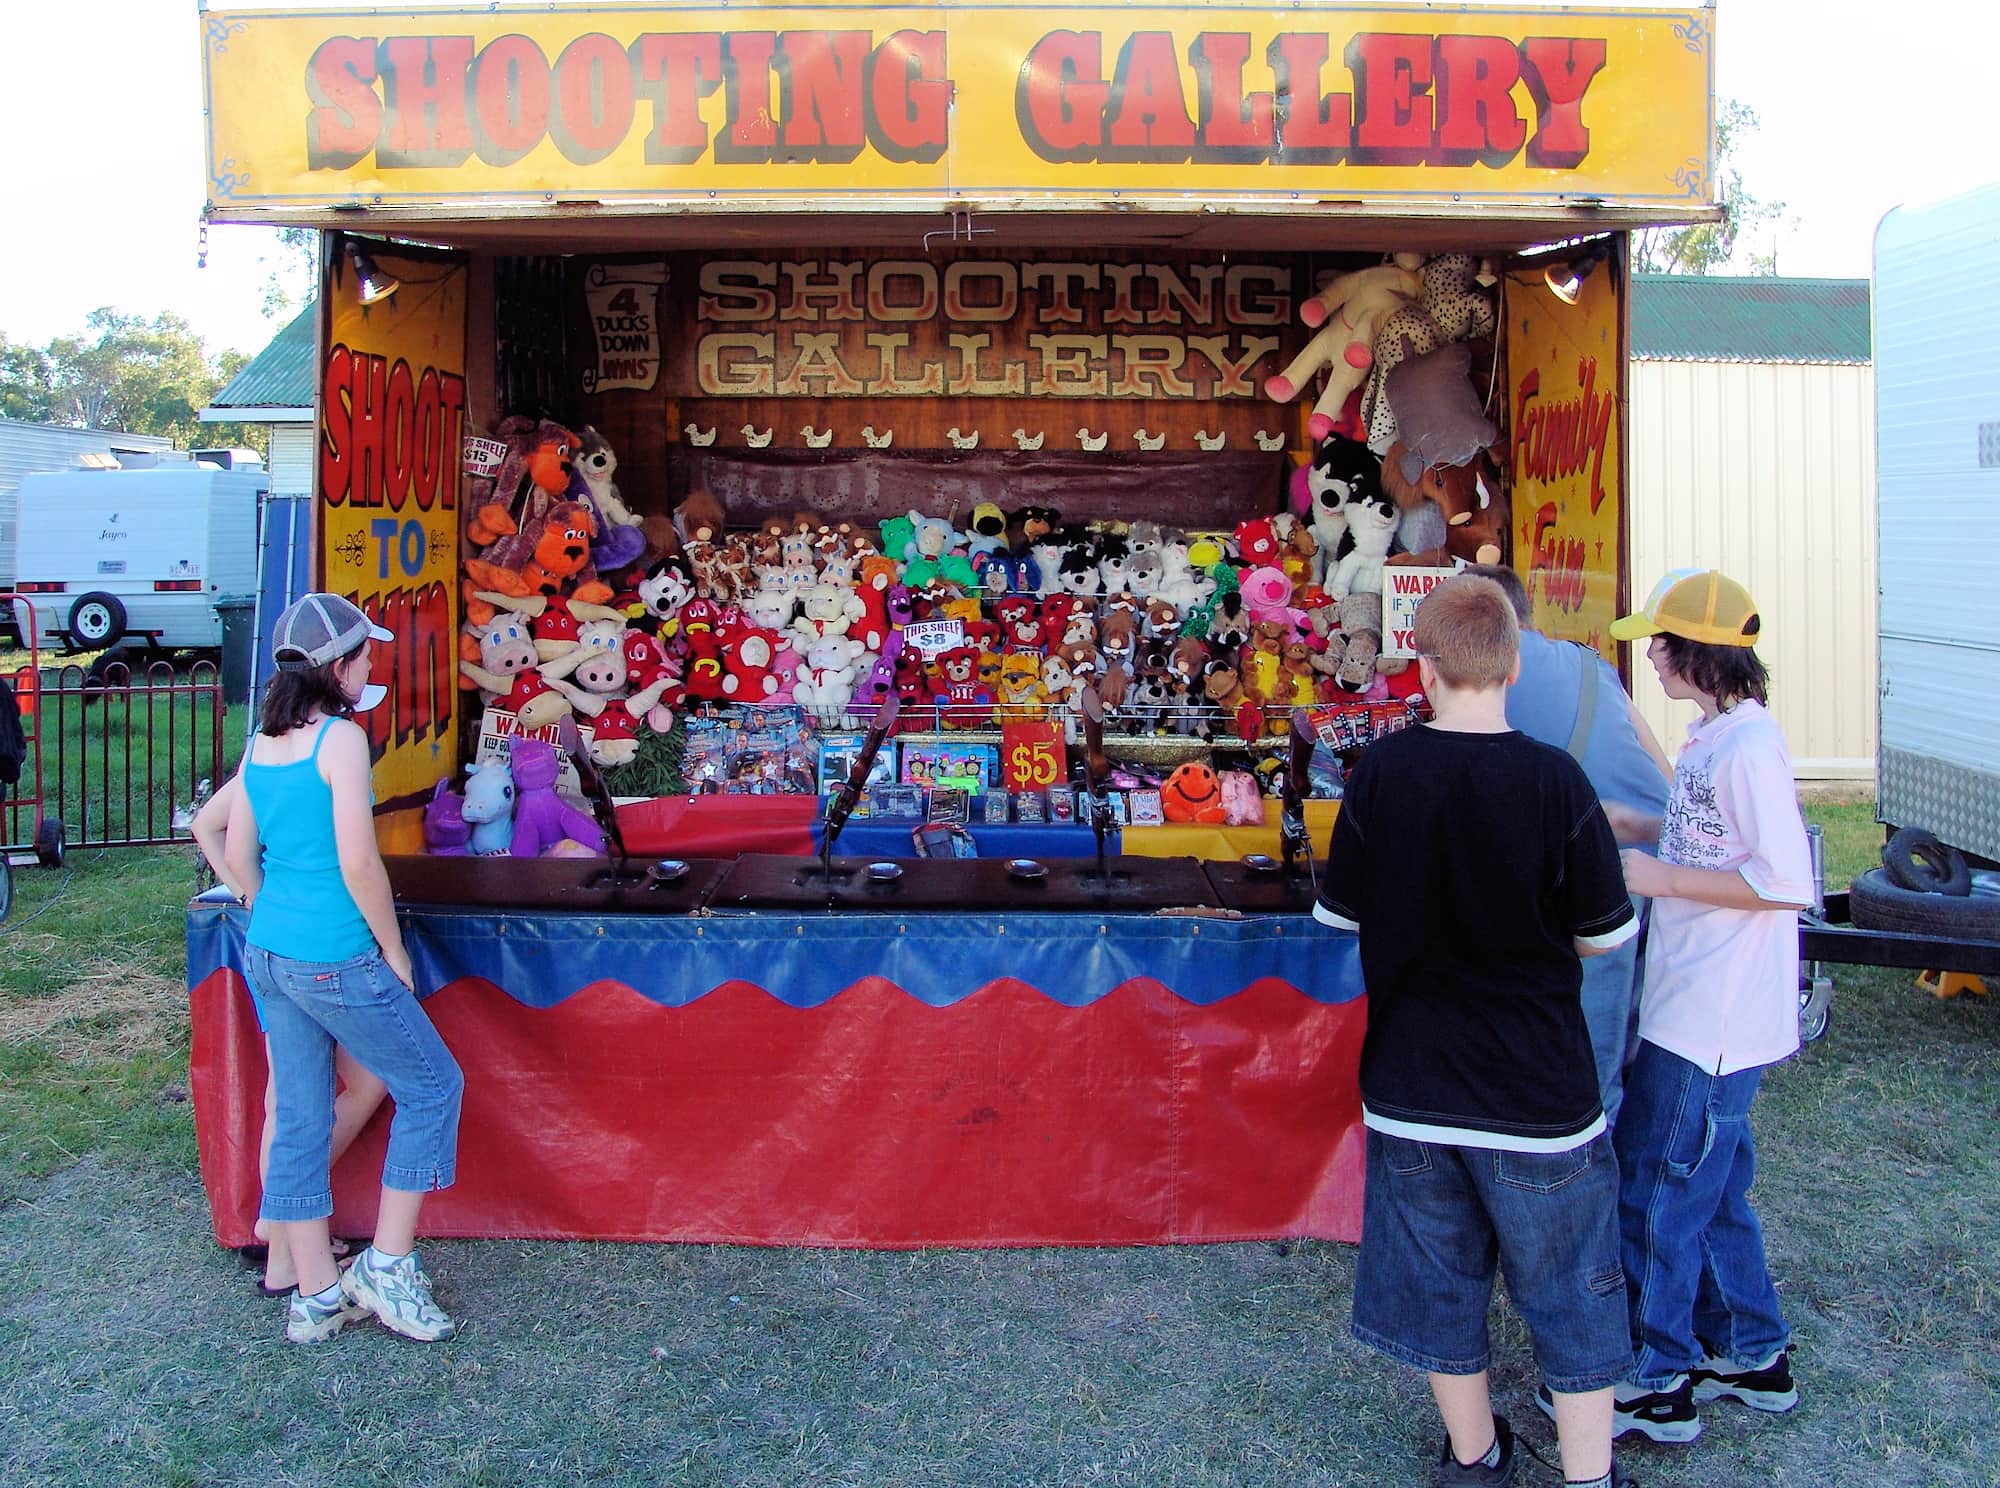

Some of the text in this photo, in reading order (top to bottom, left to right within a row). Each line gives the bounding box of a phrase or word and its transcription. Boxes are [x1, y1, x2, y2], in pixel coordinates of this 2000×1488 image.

[305, 28, 1608, 171] SHOOTING GALLERY
[608, 288, 640, 316] 4
[697, 260, 1292, 326] SHOOTING
[596, 315, 649, 333] DUCKS
[600, 334, 650, 352] DOWN
[603, 359, 649, 380] WINS
[697, 331, 1280, 397] GALLERY
[321, 342, 465, 513] SHOOT
[1511, 355, 1612, 516] Family
[464, 448, 489, 463] $15
[476, 439, 506, 458] SHELF
[370, 517, 427, 580] TO
[1526, 501, 1587, 616] Fun
[1393, 598, 1402, 611] IF
[905, 621, 960, 640] THIS SHELF
[920, 633, 946, 646] $8
[1011, 741, 1058, 788] $5
